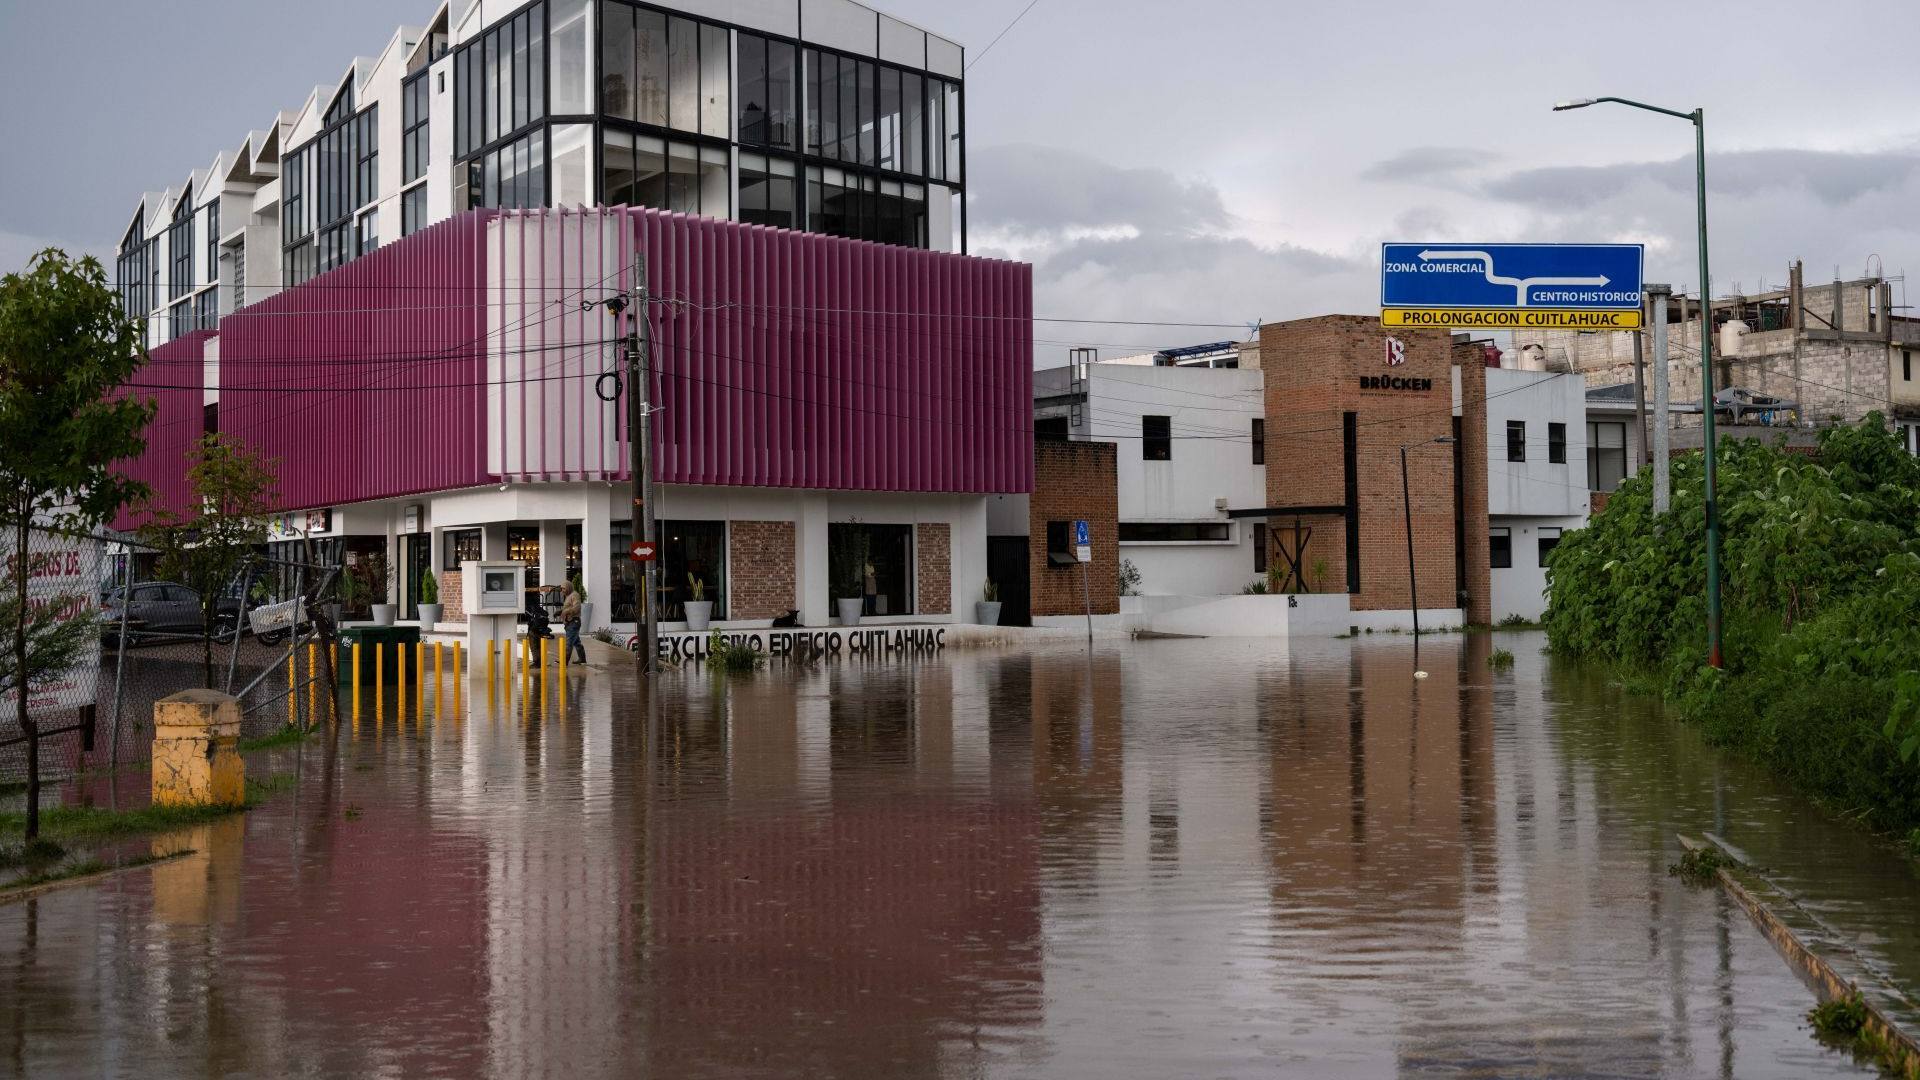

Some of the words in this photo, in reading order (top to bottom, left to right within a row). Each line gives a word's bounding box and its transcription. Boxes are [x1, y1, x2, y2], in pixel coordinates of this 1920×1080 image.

[1386, 263, 1418, 273] ZONA
[1420, 263, 1485, 273] COMERCIAL
[1532, 291, 1578, 302] CENTRO
[1579, 291, 1639, 302] HISTORICO
[1403, 312, 1519, 325] PROLONGACION
[1525, 313, 1620, 326] CUITLAHUAC
[769, 631, 842, 653] EDIFICIO
[848, 628, 946, 651] CUITLAHUAC
